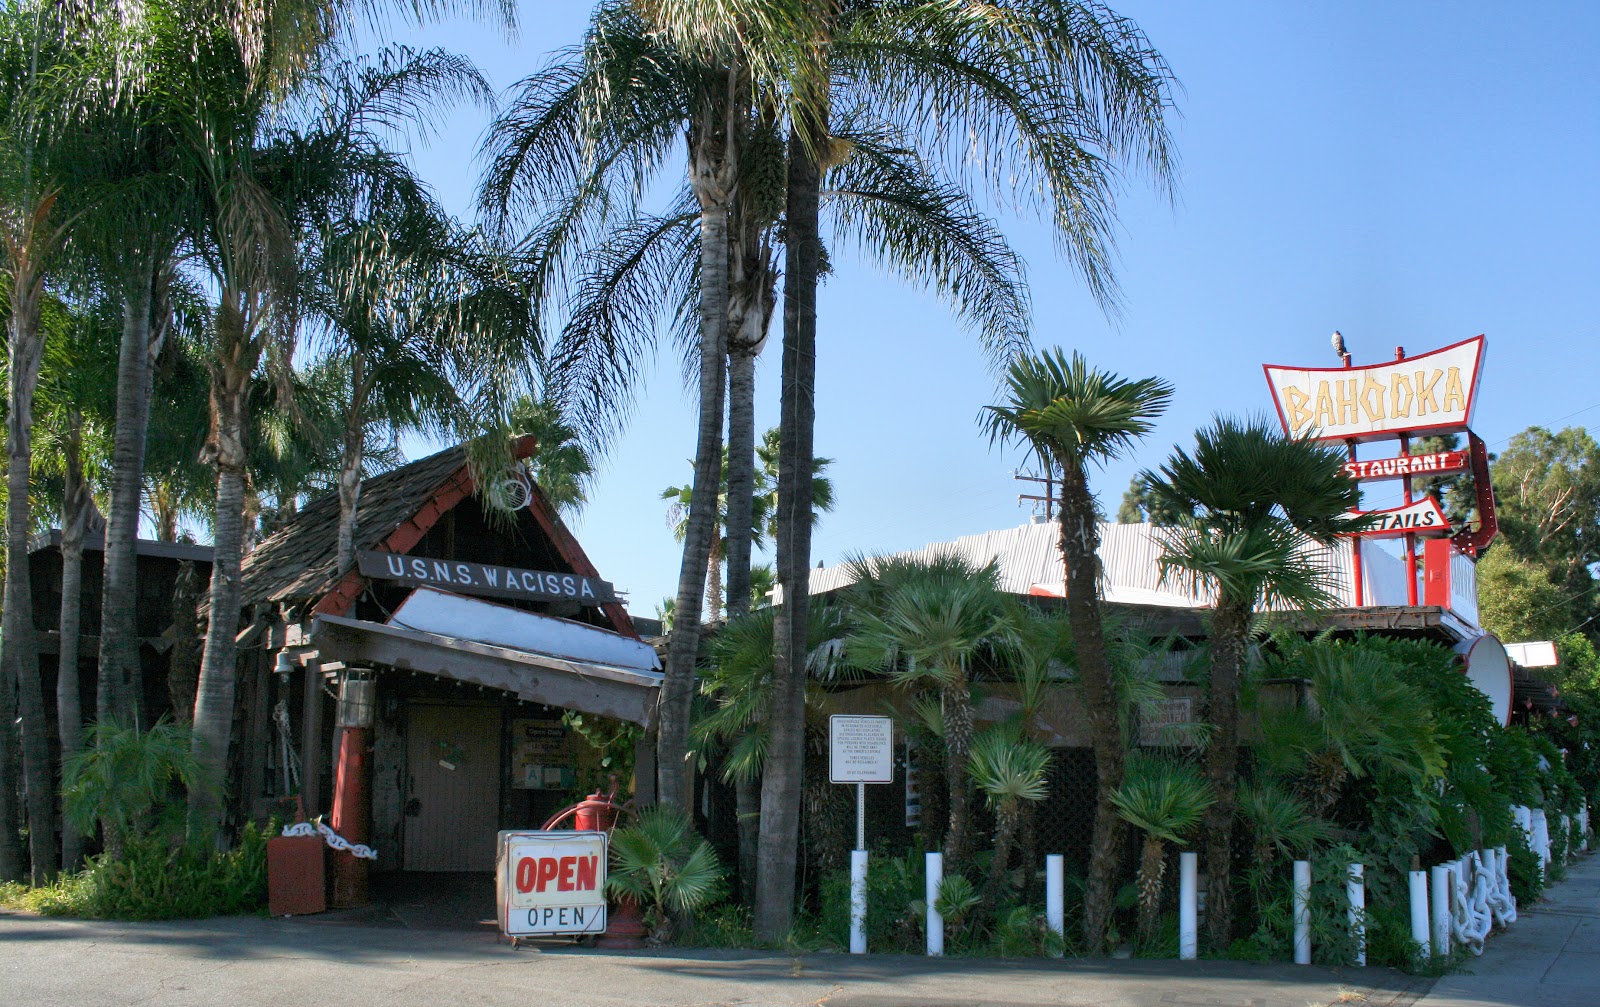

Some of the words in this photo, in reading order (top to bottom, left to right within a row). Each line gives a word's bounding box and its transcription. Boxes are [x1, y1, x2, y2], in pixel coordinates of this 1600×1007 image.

[1282, 367, 1465, 431] BAHOOKA
[1344, 453, 1449, 478] STAURANT
[1376, 509, 1434, 530] TAILS
[387, 555, 479, 586] U.S.N.S.
[483, 566, 595, 599] WACISSA
[516, 855, 598, 893] OPEN
[528, 906, 584, 926] OPEN
